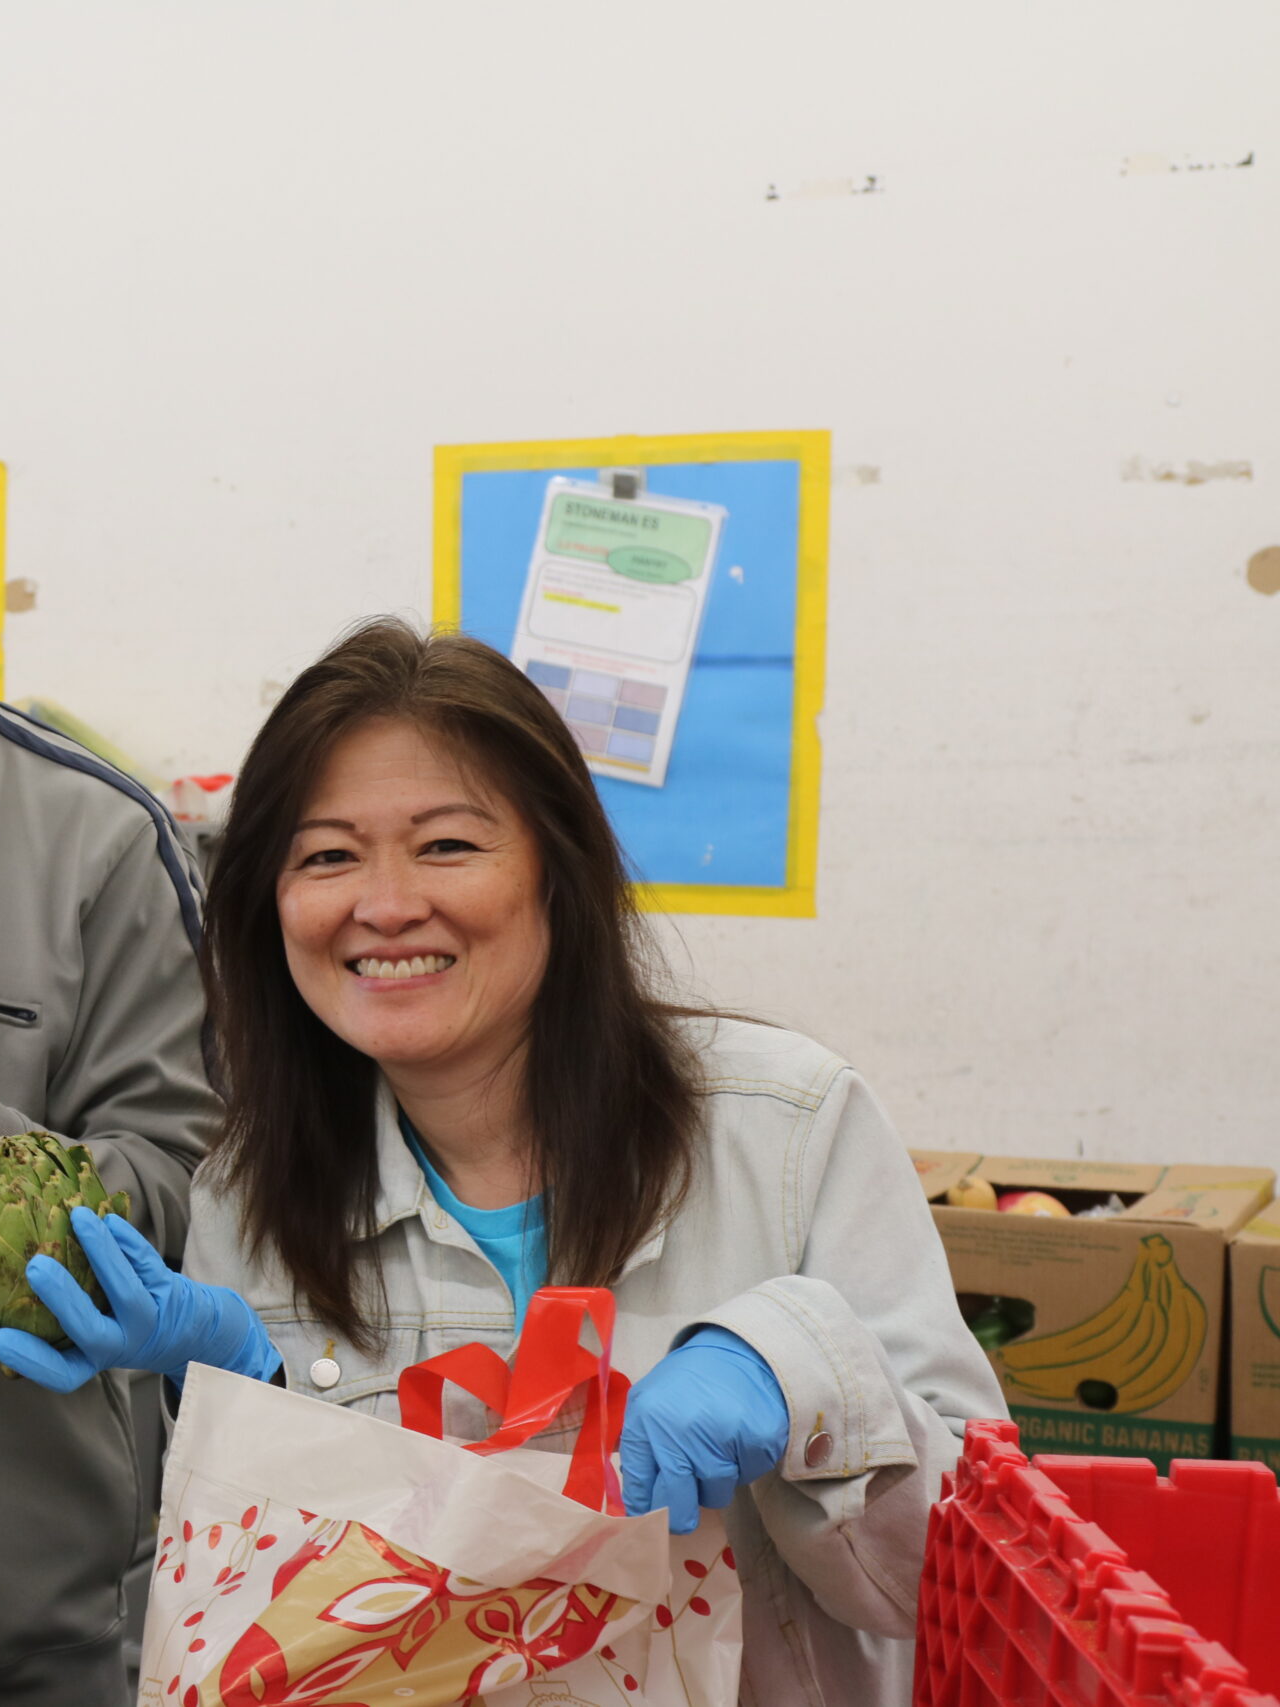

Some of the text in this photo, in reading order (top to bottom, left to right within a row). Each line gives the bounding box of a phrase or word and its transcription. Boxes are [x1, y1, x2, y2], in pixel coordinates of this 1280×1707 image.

[565, 502, 638, 526] STONEMAN
[642, 515, 659, 530] ES
[1016, 1415, 1209, 1456] RGANIC BANANAS
